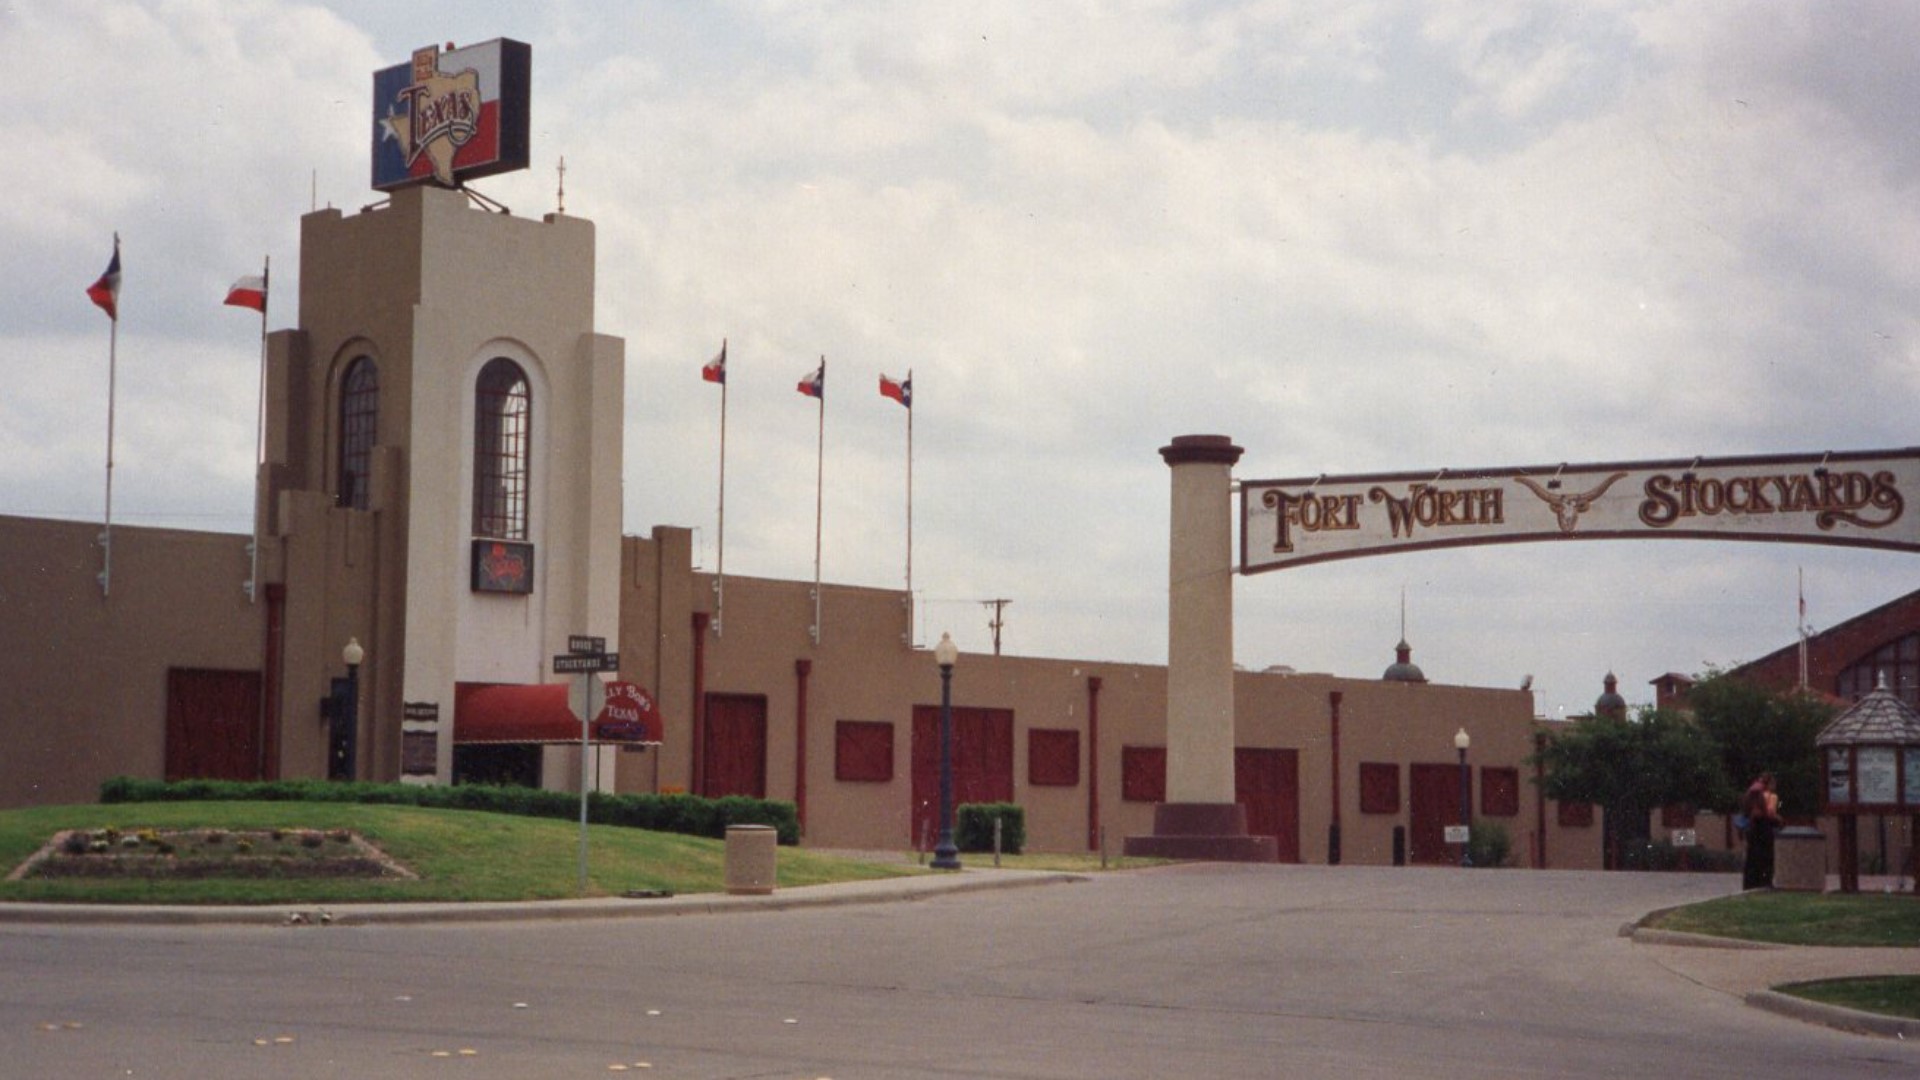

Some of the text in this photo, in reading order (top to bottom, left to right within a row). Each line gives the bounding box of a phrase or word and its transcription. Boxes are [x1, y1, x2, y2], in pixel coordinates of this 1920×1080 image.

[397, 85, 476, 169] TEXAS
[1262, 470, 1904, 553] FORT WORTH STOCKYARDS
